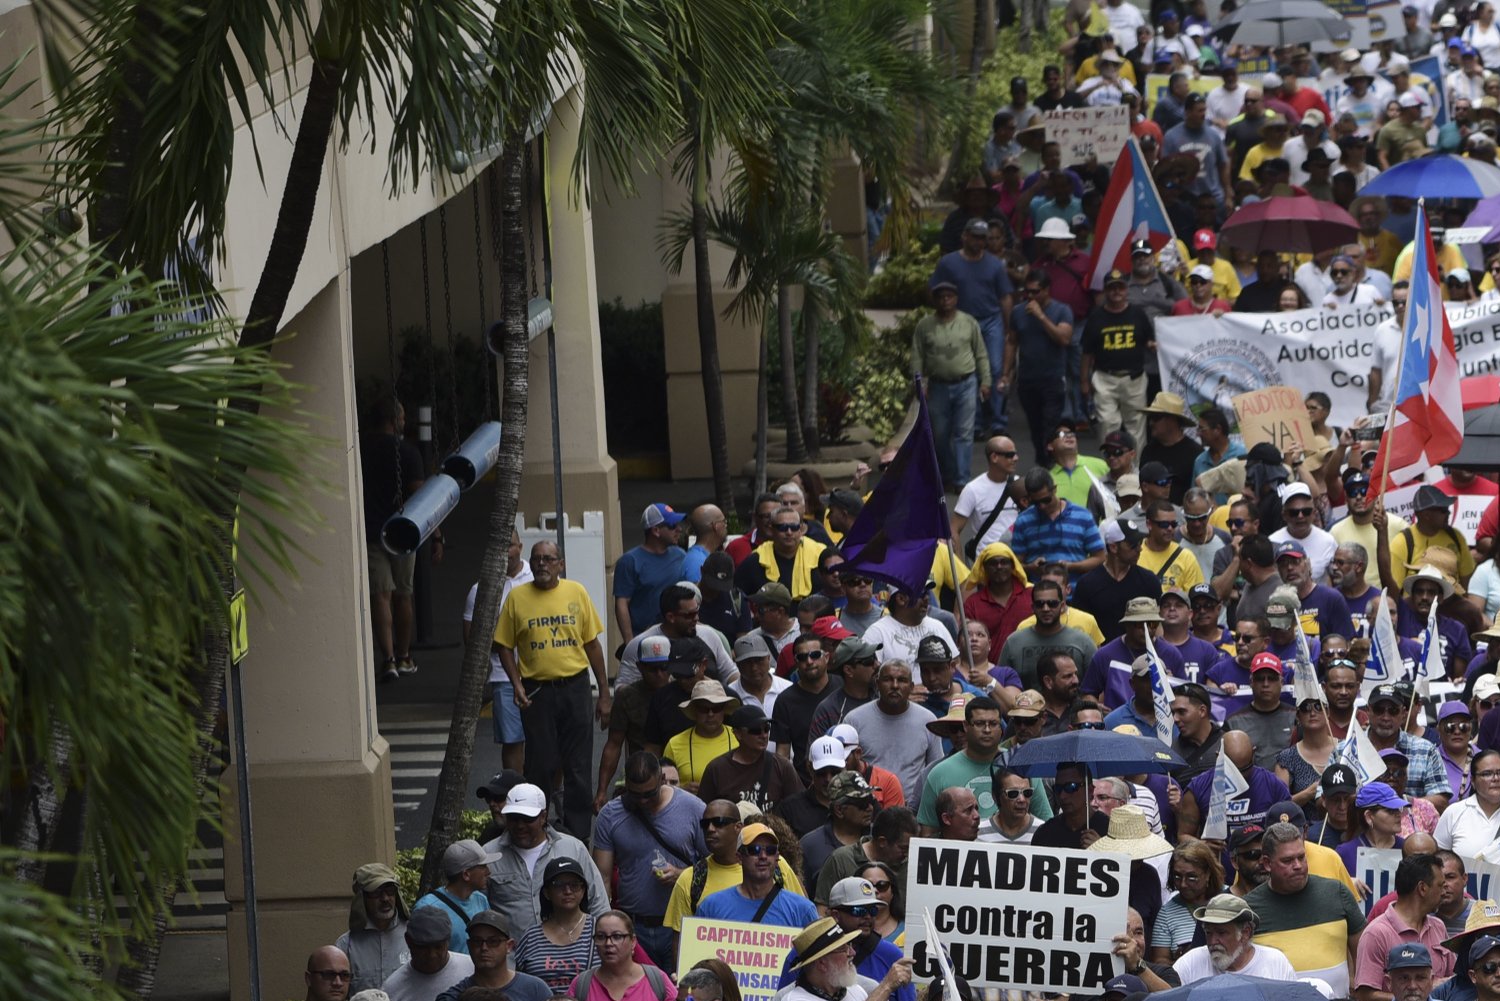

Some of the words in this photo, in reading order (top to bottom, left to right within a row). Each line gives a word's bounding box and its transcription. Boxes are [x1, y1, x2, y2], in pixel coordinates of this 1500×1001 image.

[1260, 303, 1392, 336] Asociación
[527, 615, 576, 629] FIRMES
[550, 627, 559, 637] Y
[530, 640, 548, 651] Pa'
[552, 637, 578, 648] lante
[916, 846, 1121, 899] MADRES
[934, 903, 1054, 941] contra
[1063, 906, 1097, 944] la
[715, 948, 779, 969] SALVAJE
[911, 940, 1115, 995] GUERRA
